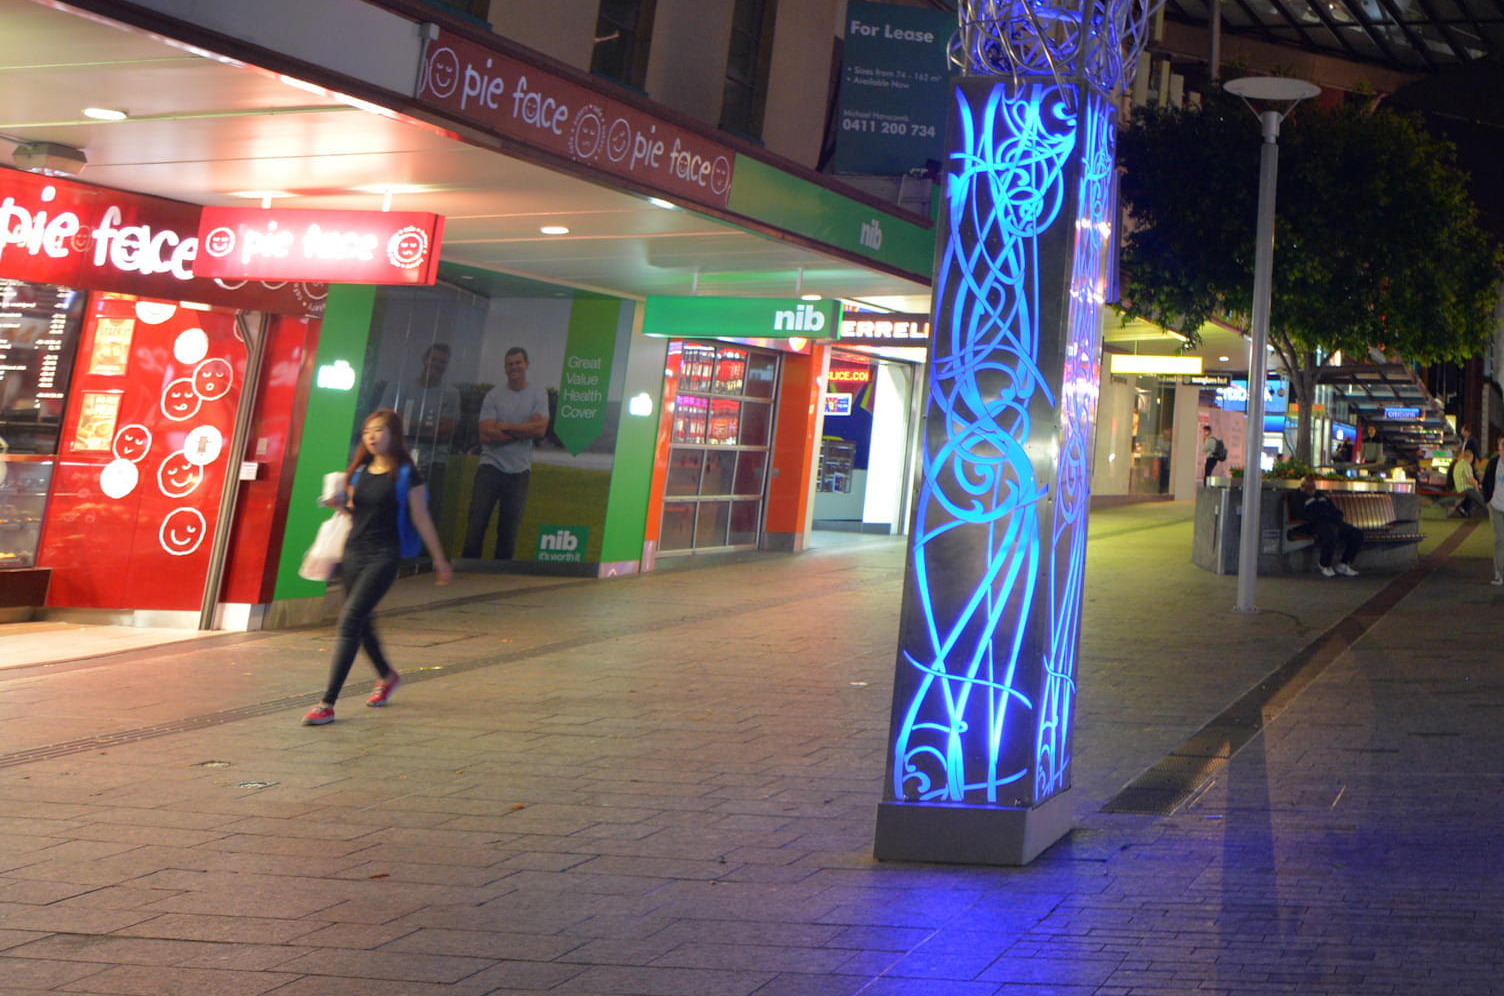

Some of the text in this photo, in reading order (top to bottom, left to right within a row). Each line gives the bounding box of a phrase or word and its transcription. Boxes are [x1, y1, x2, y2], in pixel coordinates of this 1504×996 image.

[850, 20, 935, 43] For Lease
[853, 76, 890, 87] Available
[461, 58, 504, 111] pie
[512, 76, 568, 136] face
[842, 118, 936, 138] 0411 200 734
[629, 125, 664, 171] pie
[669, 138, 711, 187] face
[0, 186, 198, 280] pie face
[241, 221, 293, 265] pie
[860, 218, 882, 251] nib
[774, 304, 825, 332] nib
[840, 320, 930, 339] ERREL
[567, 355, 602, 370] Great
[566, 372, 599, 387] Value
[563, 388, 603, 403] Health
[561, 405, 598, 420] Cover
[540, 529, 578, 551] nib
